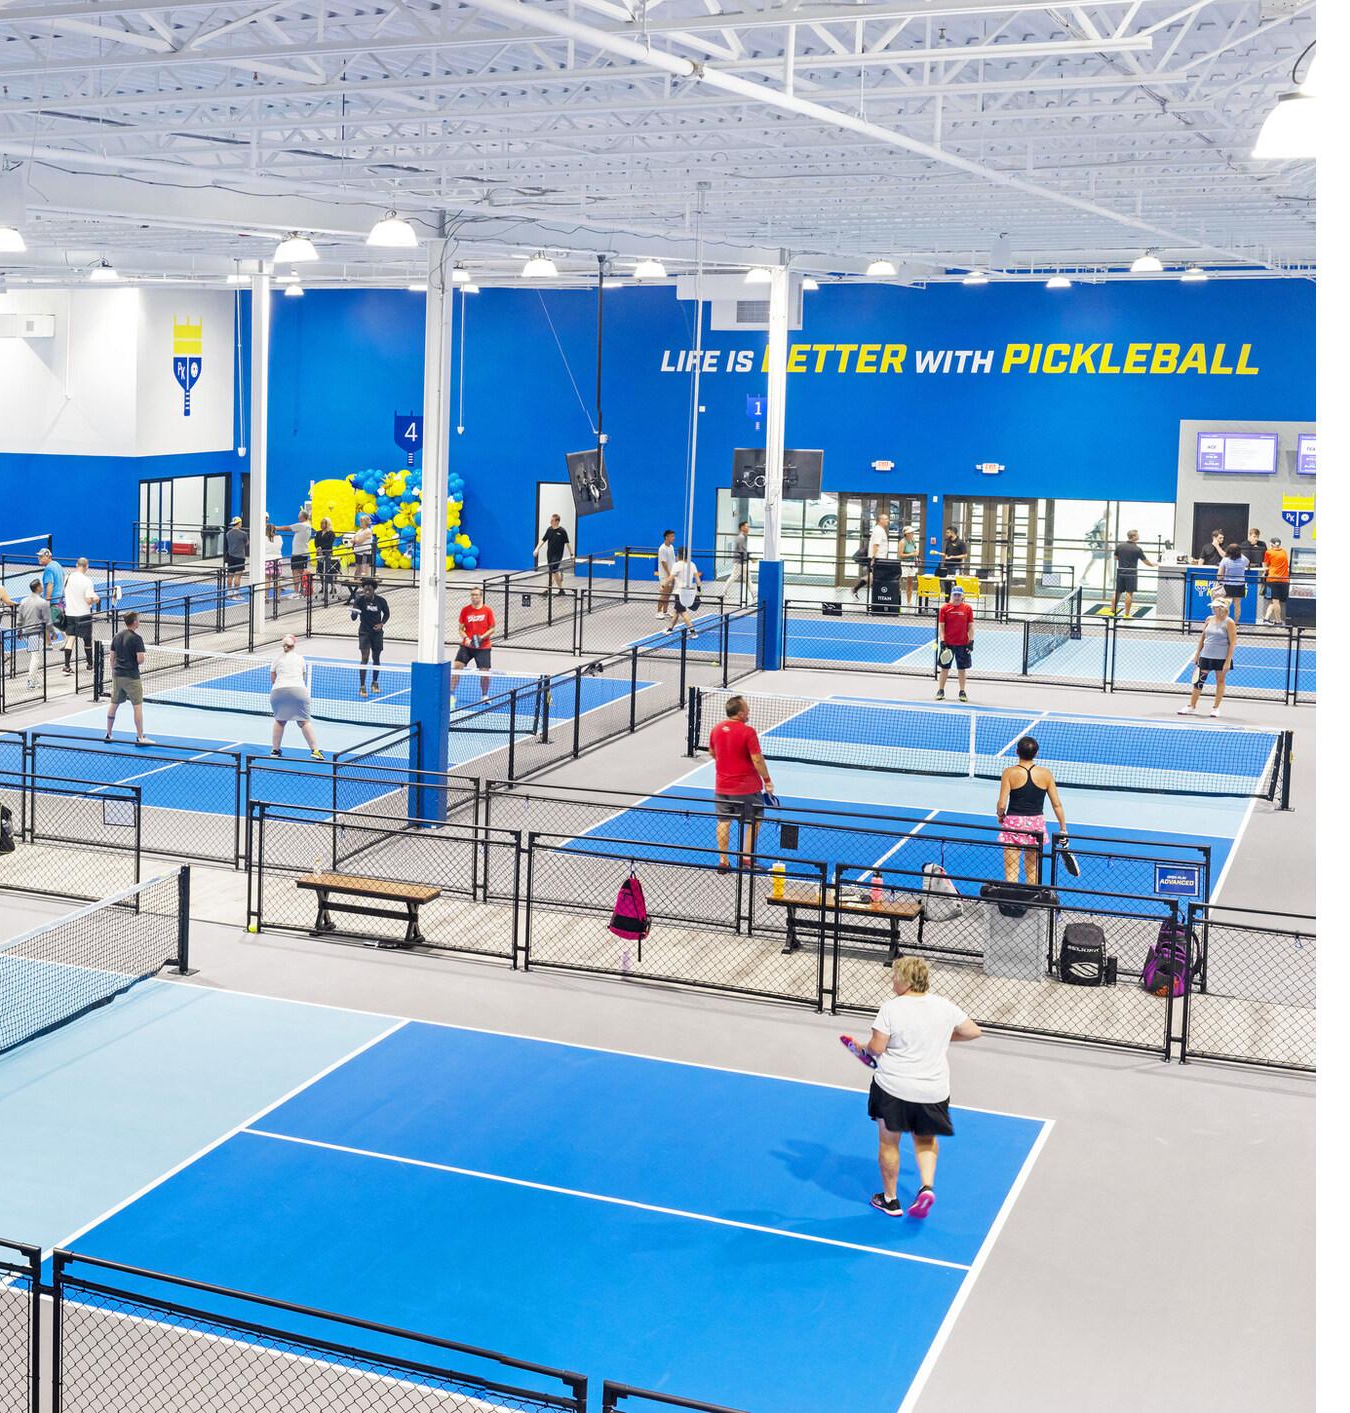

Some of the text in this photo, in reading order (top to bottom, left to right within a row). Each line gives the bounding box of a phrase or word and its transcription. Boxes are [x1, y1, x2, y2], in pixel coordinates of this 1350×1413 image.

[660, 343, 1260, 375] LIFE IS ETTER WITH PICKLEBALL
[177, 361, 186, 380] PK
[754, 401, 762, 416] 1
[404, 422, 418, 442] 4
[1159, 878, 1195, 886] ADVANCED
